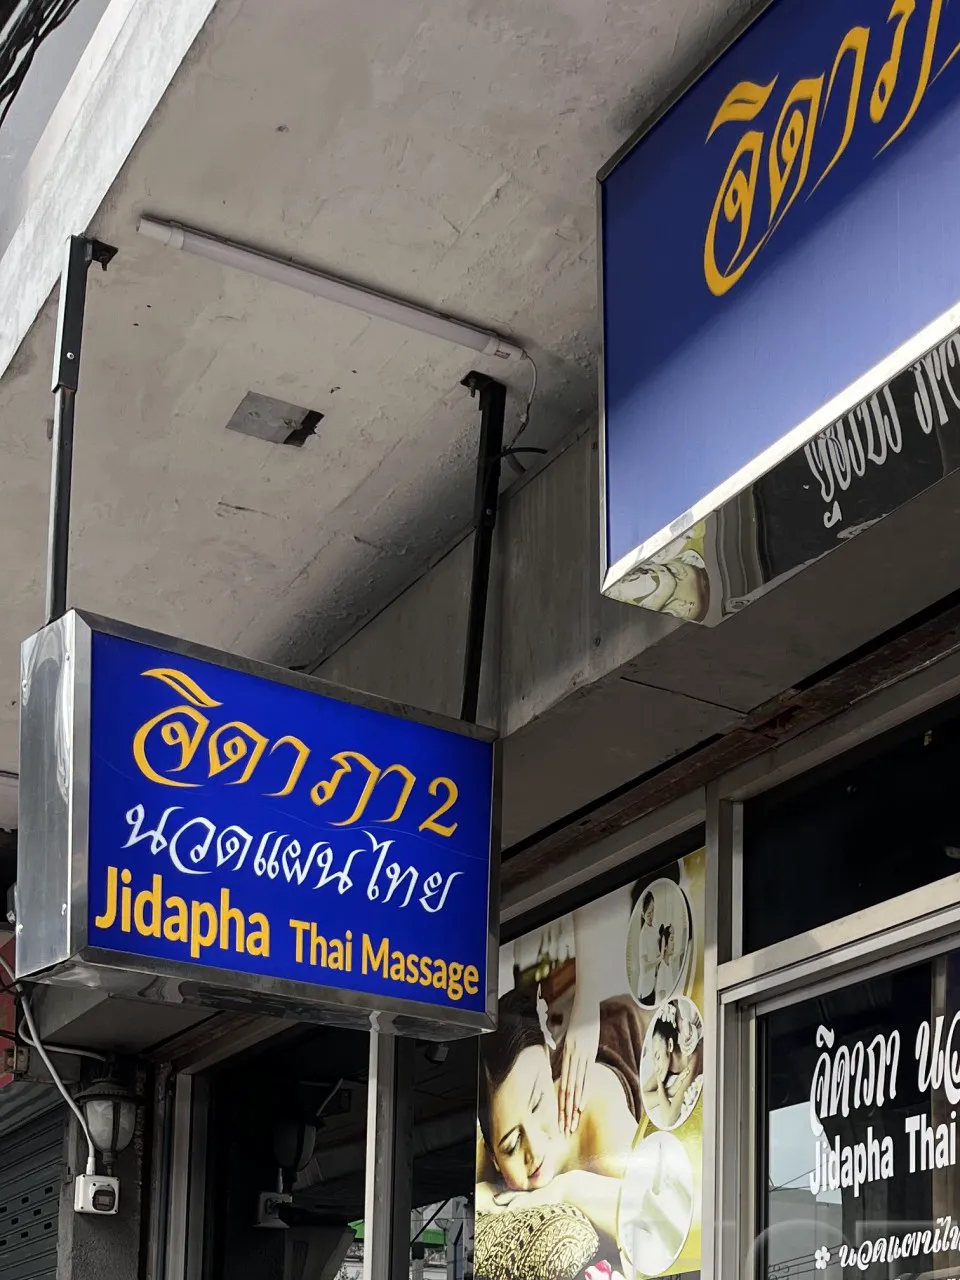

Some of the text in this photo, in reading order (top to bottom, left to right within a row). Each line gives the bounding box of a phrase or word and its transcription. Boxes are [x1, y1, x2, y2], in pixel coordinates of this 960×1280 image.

[121, 803, 465, 913] นวดแผนไทย
[95, 866, 480, 1000] Jidapha Thai Massage
[809, 1126, 895, 1198] Jidapha
[905, 1110, 957, 1173] Thai
